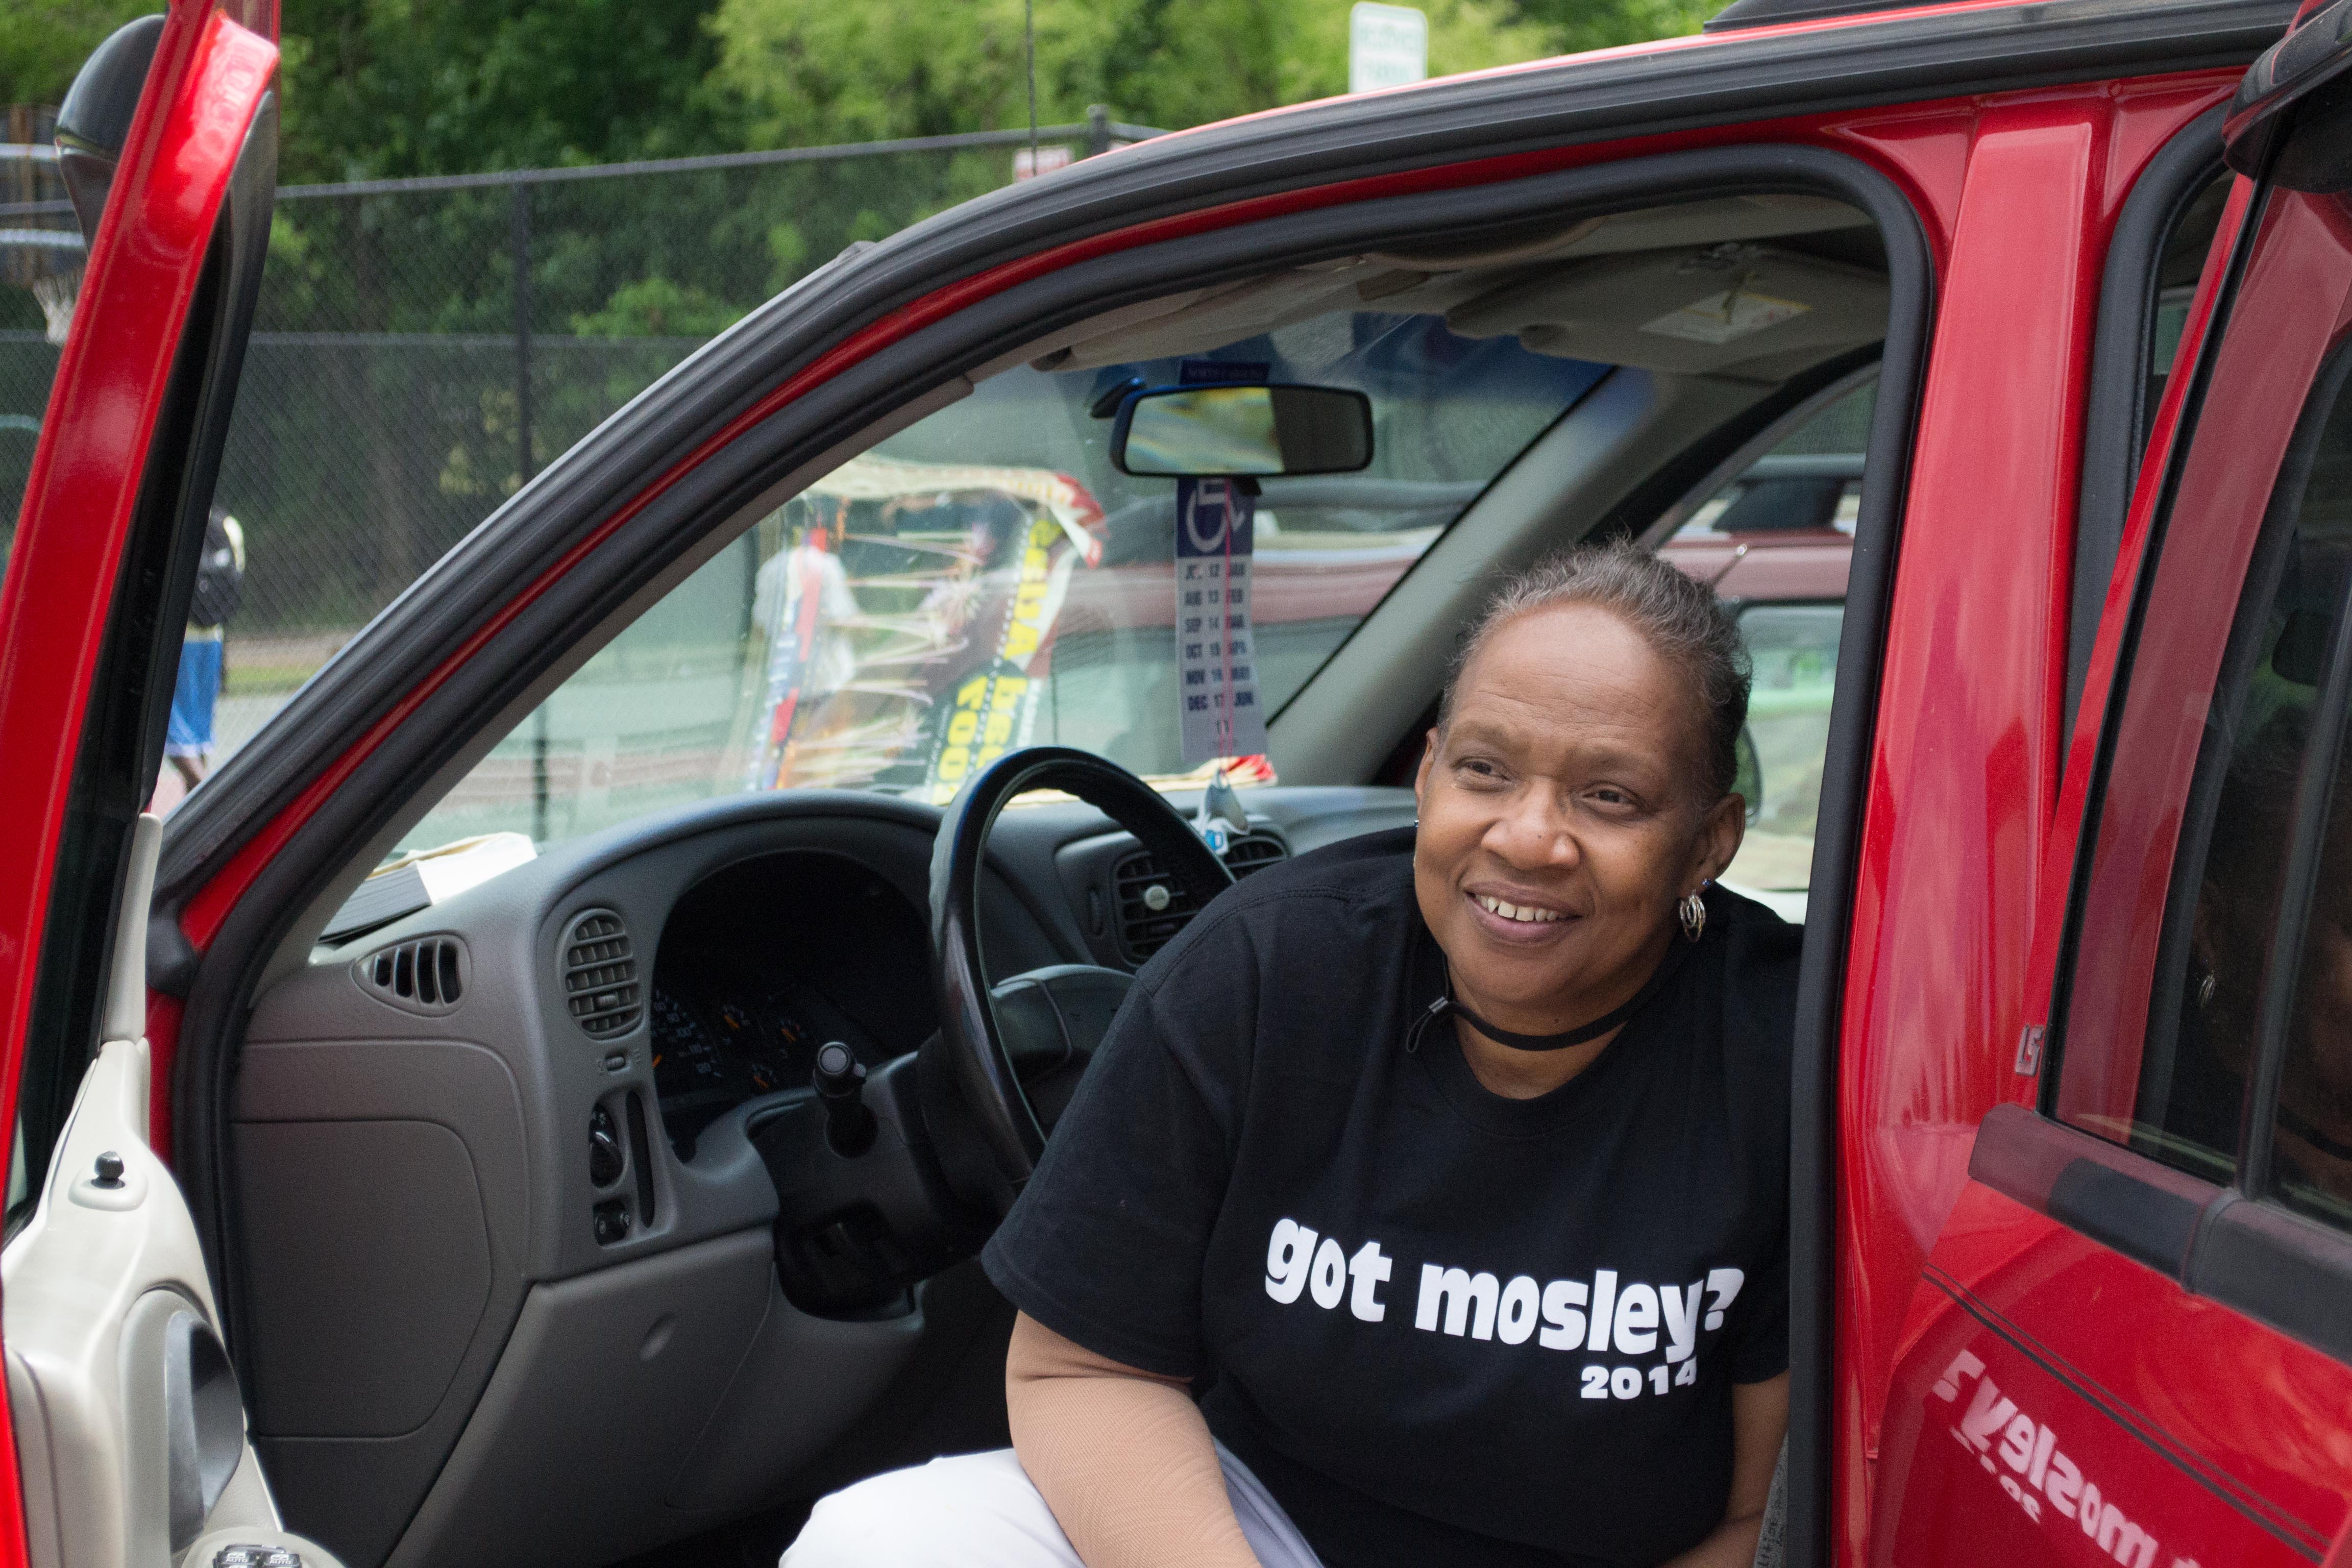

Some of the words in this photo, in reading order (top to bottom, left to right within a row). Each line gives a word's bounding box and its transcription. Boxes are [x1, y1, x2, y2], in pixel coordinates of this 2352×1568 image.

[1187, 694, 1208, 711] DEC
[1265, 1217, 1393, 1323] got
[1414, 1263, 1745, 1364] mosley?
[1580, 1357, 1697, 1400] 2014
